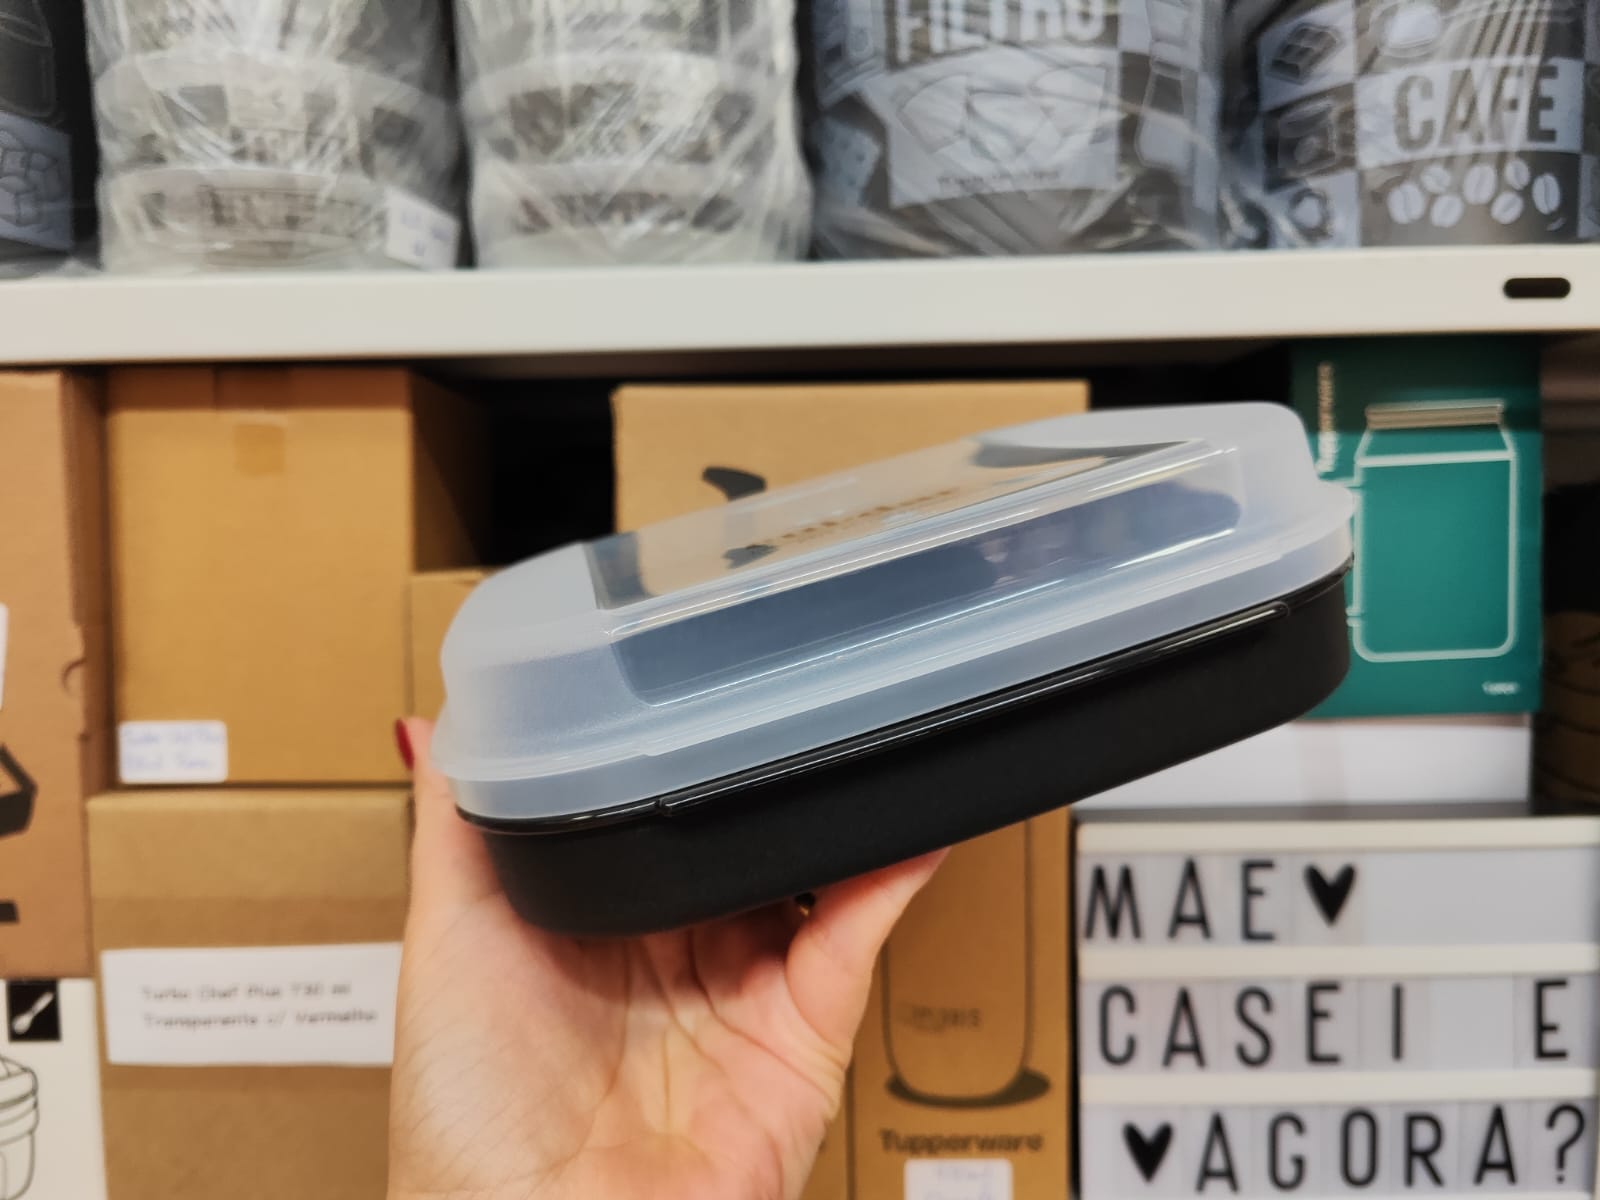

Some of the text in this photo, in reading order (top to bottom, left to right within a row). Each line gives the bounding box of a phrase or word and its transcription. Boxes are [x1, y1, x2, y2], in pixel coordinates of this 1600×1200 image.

[1083, 857, 1276, 941] MAE
[1098, 978, 1570, 1068] CASEI E
[1196, 1104, 1586, 1194] AGORA?
